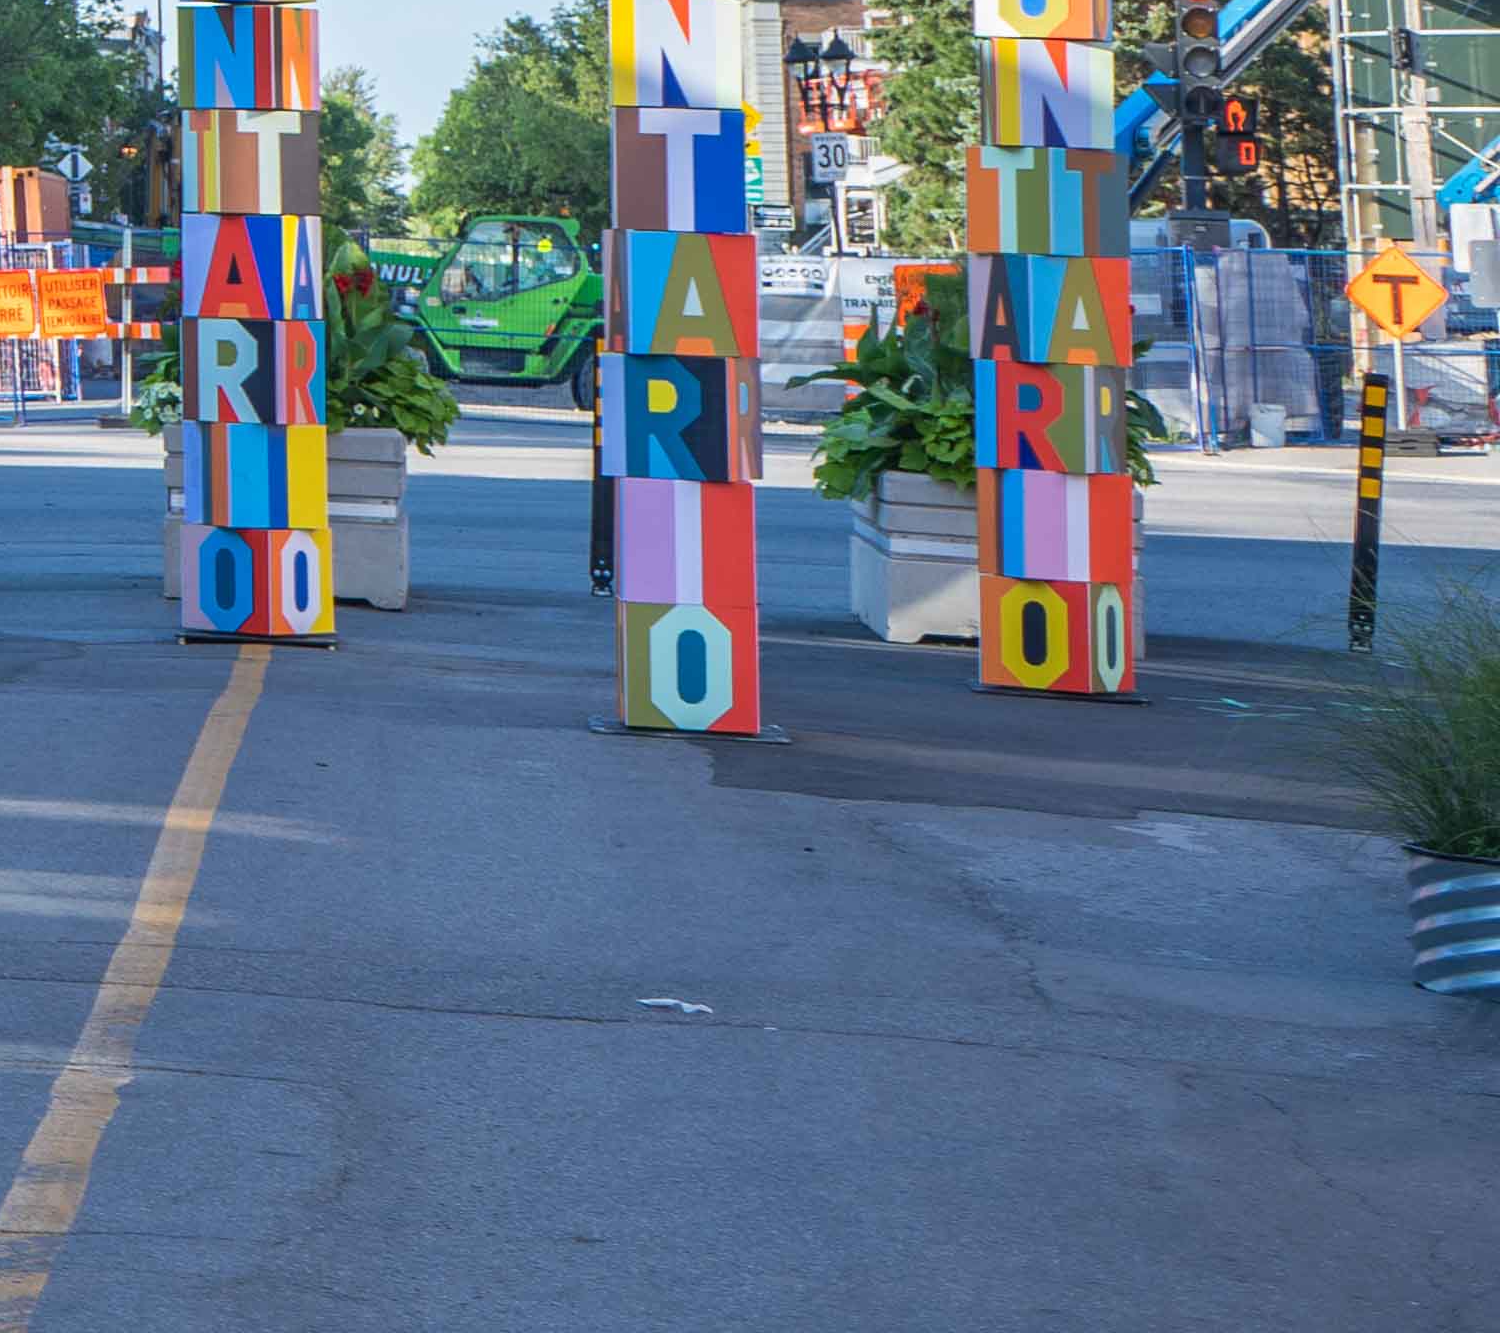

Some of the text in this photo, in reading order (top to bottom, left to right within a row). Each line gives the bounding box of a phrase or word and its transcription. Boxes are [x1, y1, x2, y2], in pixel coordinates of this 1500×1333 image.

[817, 143, 846, 169] 30
[44, 278, 98, 293] UTILISER
[47, 296, 99, 310] PASSAGE
